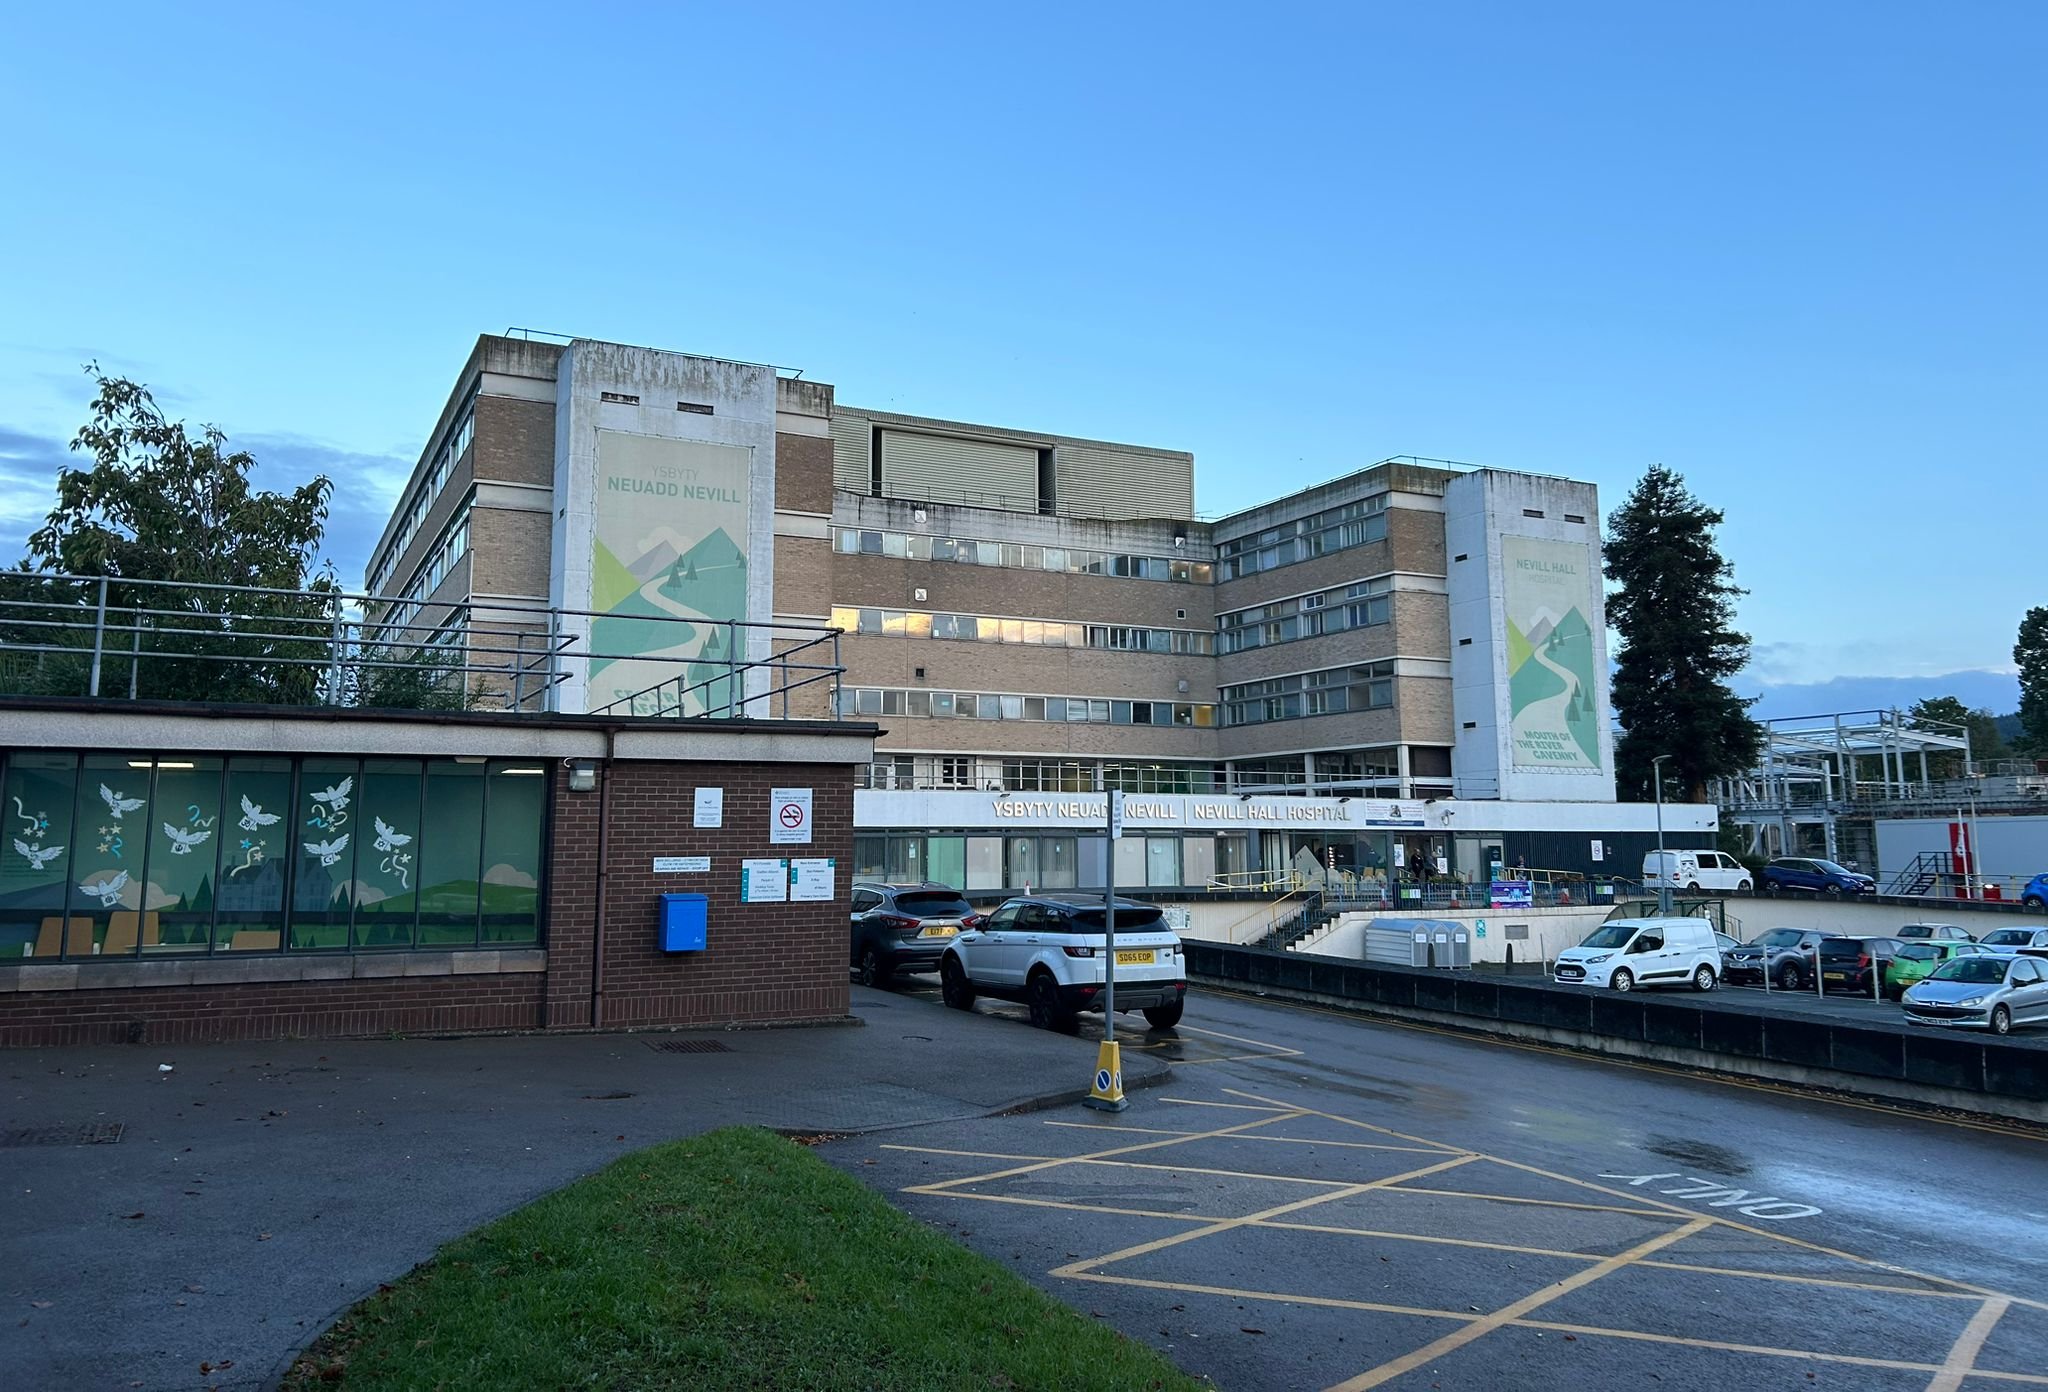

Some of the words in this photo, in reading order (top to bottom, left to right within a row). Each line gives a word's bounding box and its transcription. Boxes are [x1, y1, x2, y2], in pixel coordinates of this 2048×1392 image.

[652, 465, 699, 480] YSBYTY
[607, 476, 679, 496] NEUADD
[683, 485, 741, 503] NEVILL
[1516, 558, 1550, 572] NEVILL
[1552, 562, 1577, 575] HALL
[1524, 730, 1559, 740] MOUTH
[1559, 733, 1571, 741] OF
[1516, 740, 1535, 748] THE
[1535, 741, 1564, 750] RIVER
[992, 801, 1054, 818] YSBYTY
[1057, 802, 1108, 818] NEUAD
[1124, 803, 1177, 819] NEVILL
[1194, 804, 1244, 820] NEVILL
[1247, 805, 1284, 821] HALL
[1286, 805, 1351, 822] HOSPITAL
[1597, 1173, 1822, 1219] ONLY
